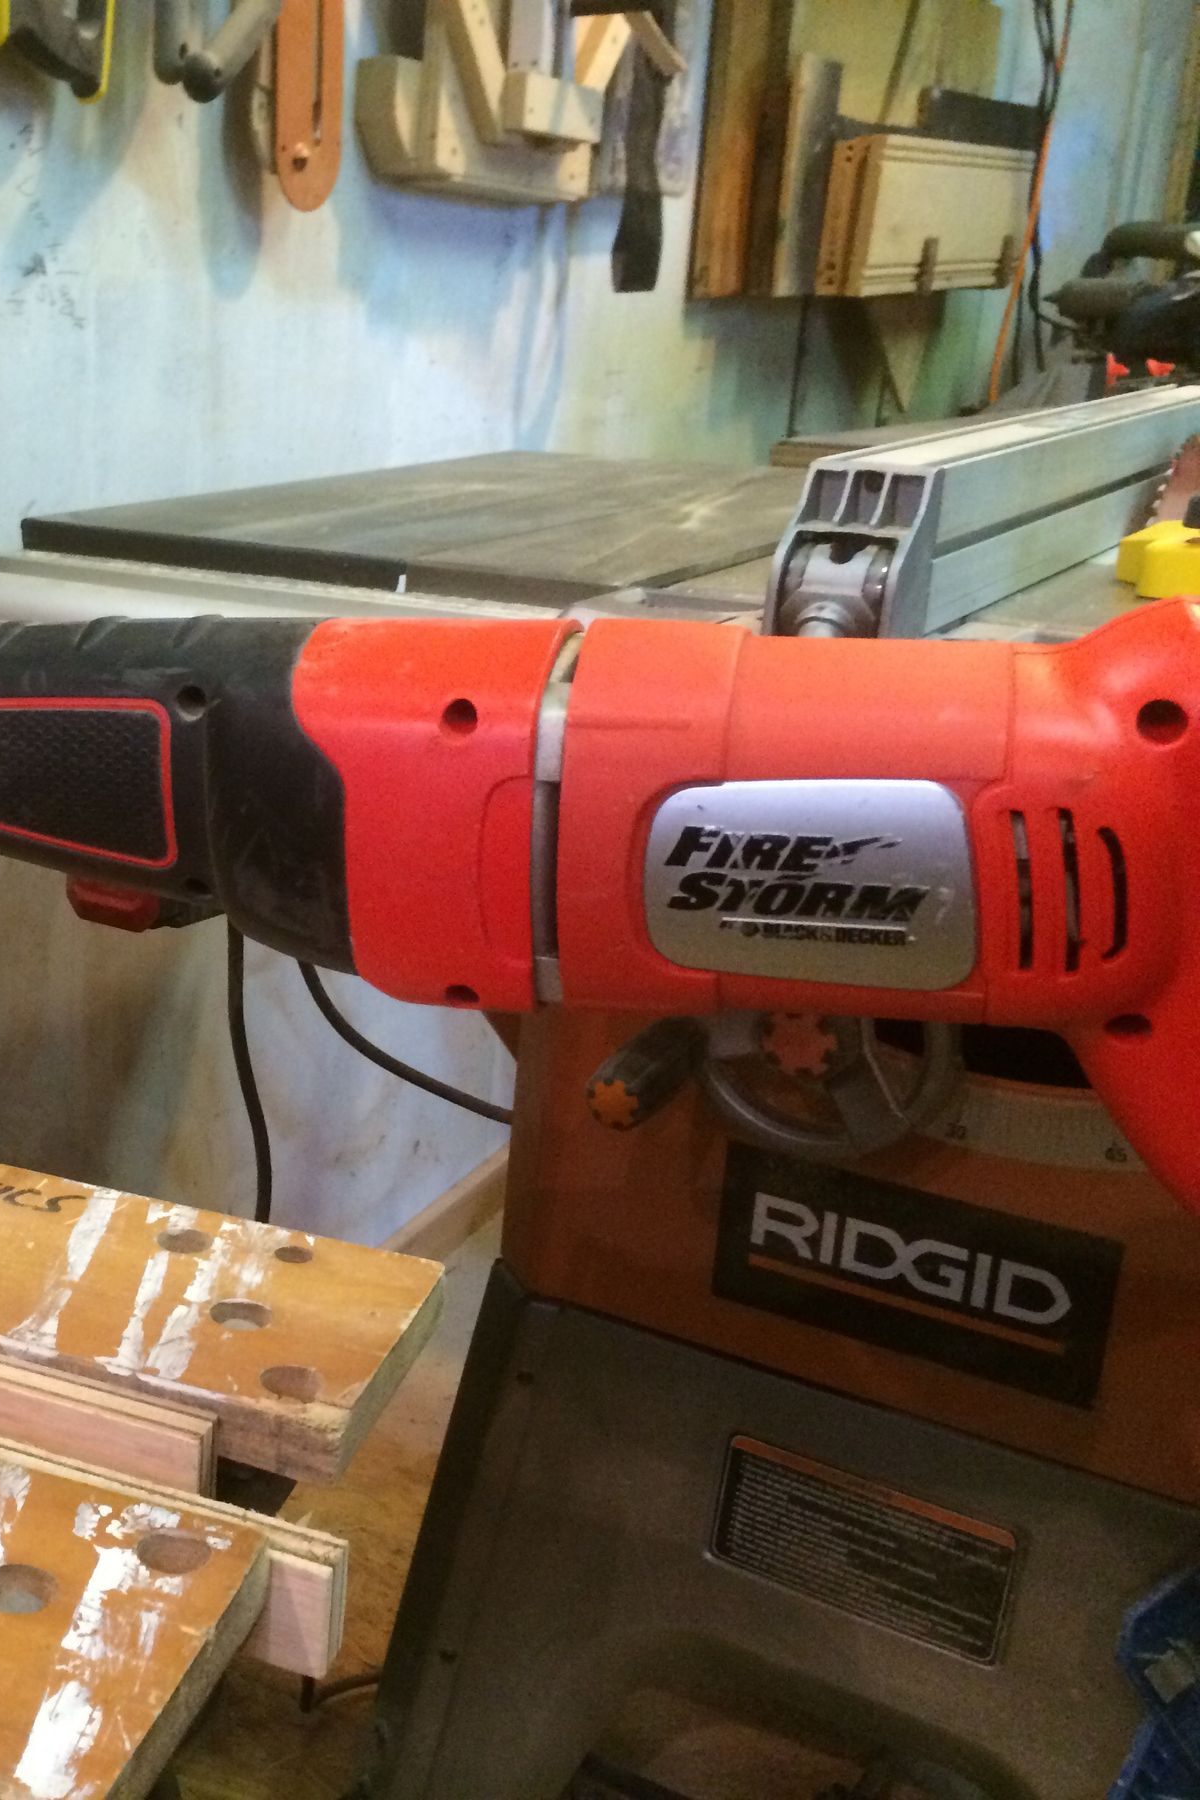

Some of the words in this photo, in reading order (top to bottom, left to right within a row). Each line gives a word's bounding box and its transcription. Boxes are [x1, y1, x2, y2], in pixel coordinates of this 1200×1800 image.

[664, 826, 836, 872] FIRE
[667, 871, 931, 922] STORM
[749, 1191, 1073, 1326] RIDGID
